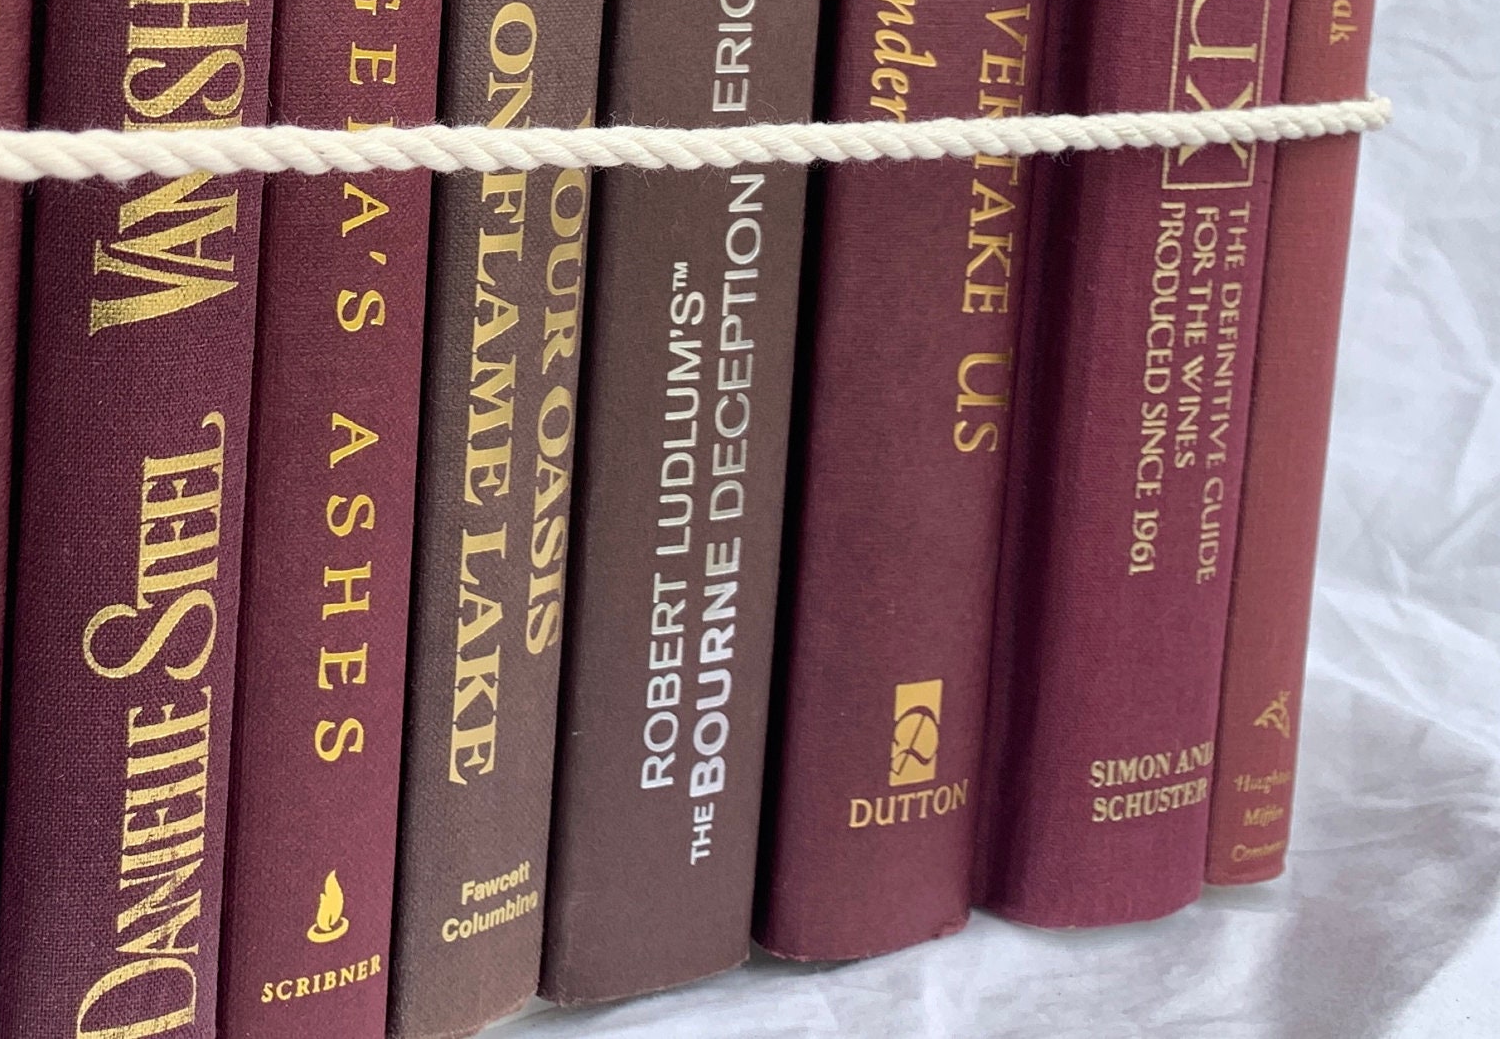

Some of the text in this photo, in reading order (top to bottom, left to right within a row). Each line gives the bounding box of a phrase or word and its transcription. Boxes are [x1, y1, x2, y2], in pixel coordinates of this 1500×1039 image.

[463, 167, 527, 506] FLAME
[1128, 201, 1186, 576] PRODUCED SINCE 1961
[1174, 206, 1219, 469] FOR THE WINES
[1196, 201, 1250, 584] THE DEFINITIVE GUIDE
[314, 412, 380, 761] ASHES
[526, 385, 573, 655] OASIS
[690, 173, 764, 865] THE BOURNE DECEPTION
[76, 411, 226, 1039] DANIELLE STEEL
[448, 522, 507, 785] LAKE
[641, 573, 687, 789] ROBERT
[1089, 752, 1173, 788] SIMON
[442, 891, 538, 943] Columbine
[461, 860, 530, 906] Fawcett
[849, 779, 969, 828] DUTTON
[1091, 777, 1208, 822] SCHUSTER
[261, 954, 381, 1003] SCRIBNER
